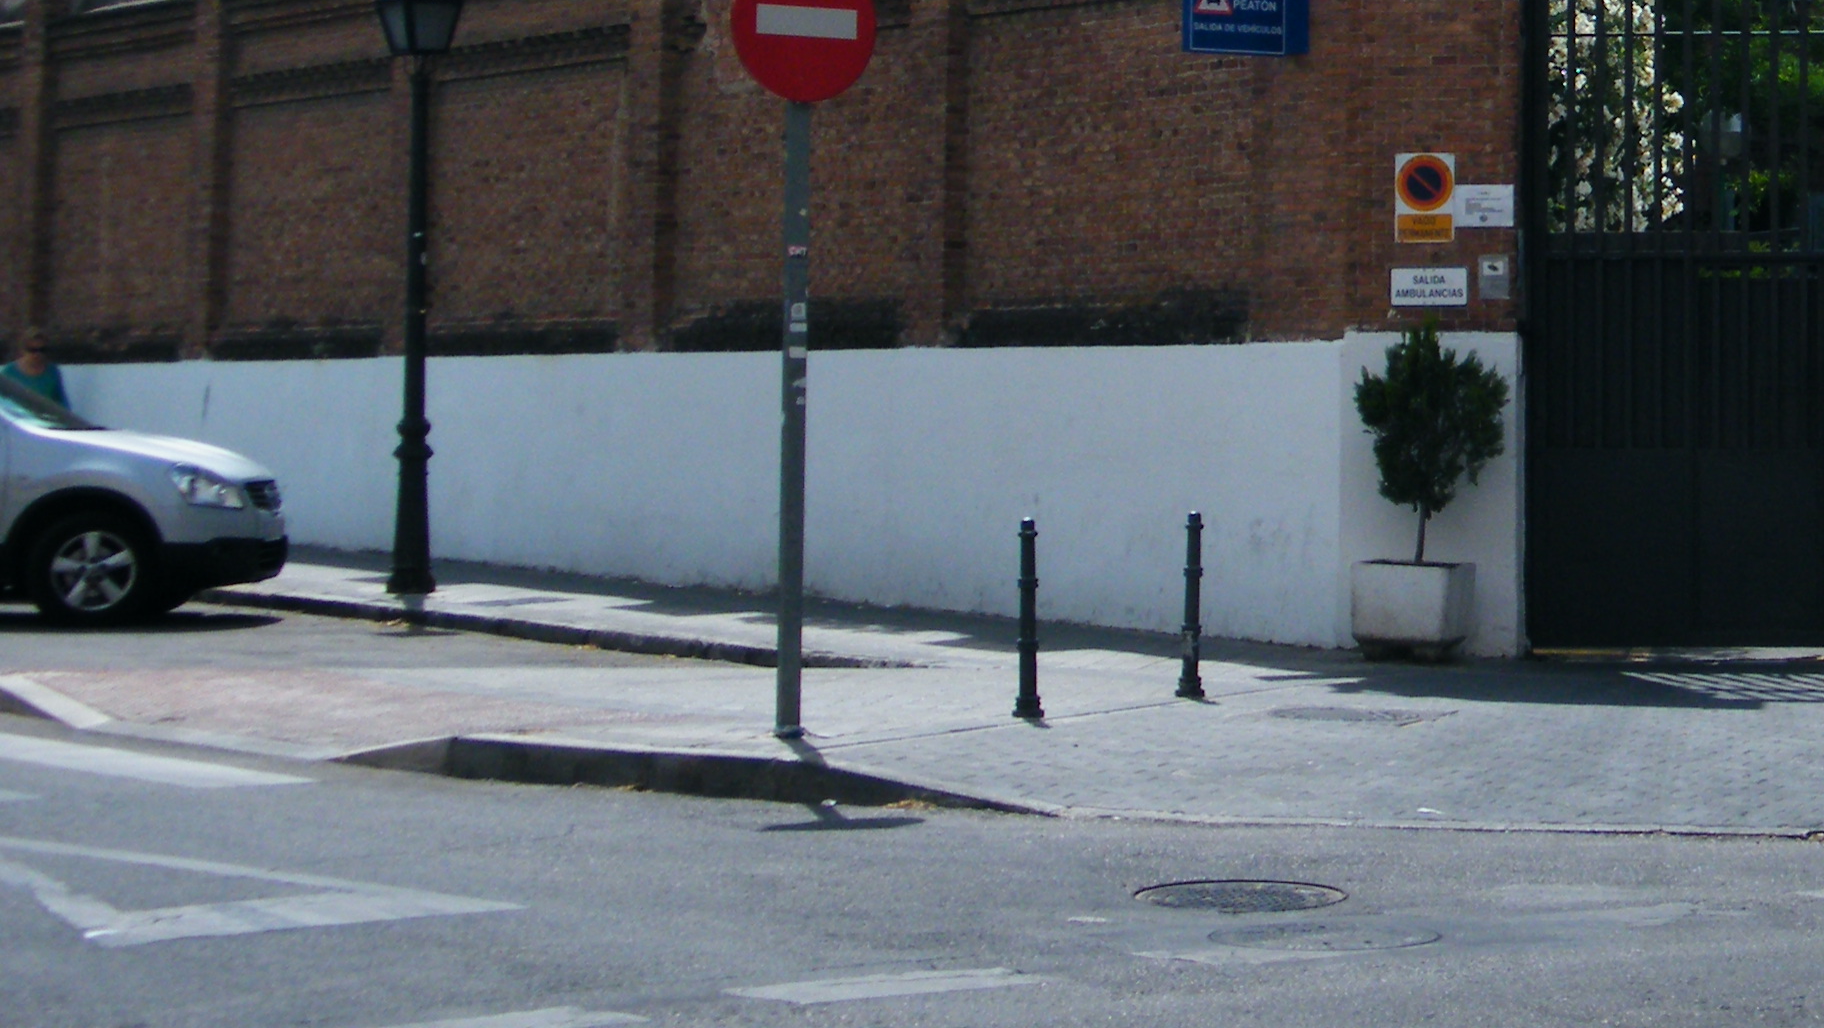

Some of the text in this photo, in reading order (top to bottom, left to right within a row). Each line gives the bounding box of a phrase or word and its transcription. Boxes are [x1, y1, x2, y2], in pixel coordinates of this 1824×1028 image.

[1193, 22, 1223, 32] SALIDA
[1224, 23, 1236, 33] DE
[1412, 275, 1446, 285] SALIDA
[1395, 288, 1464, 299] AMBULANCIAS
